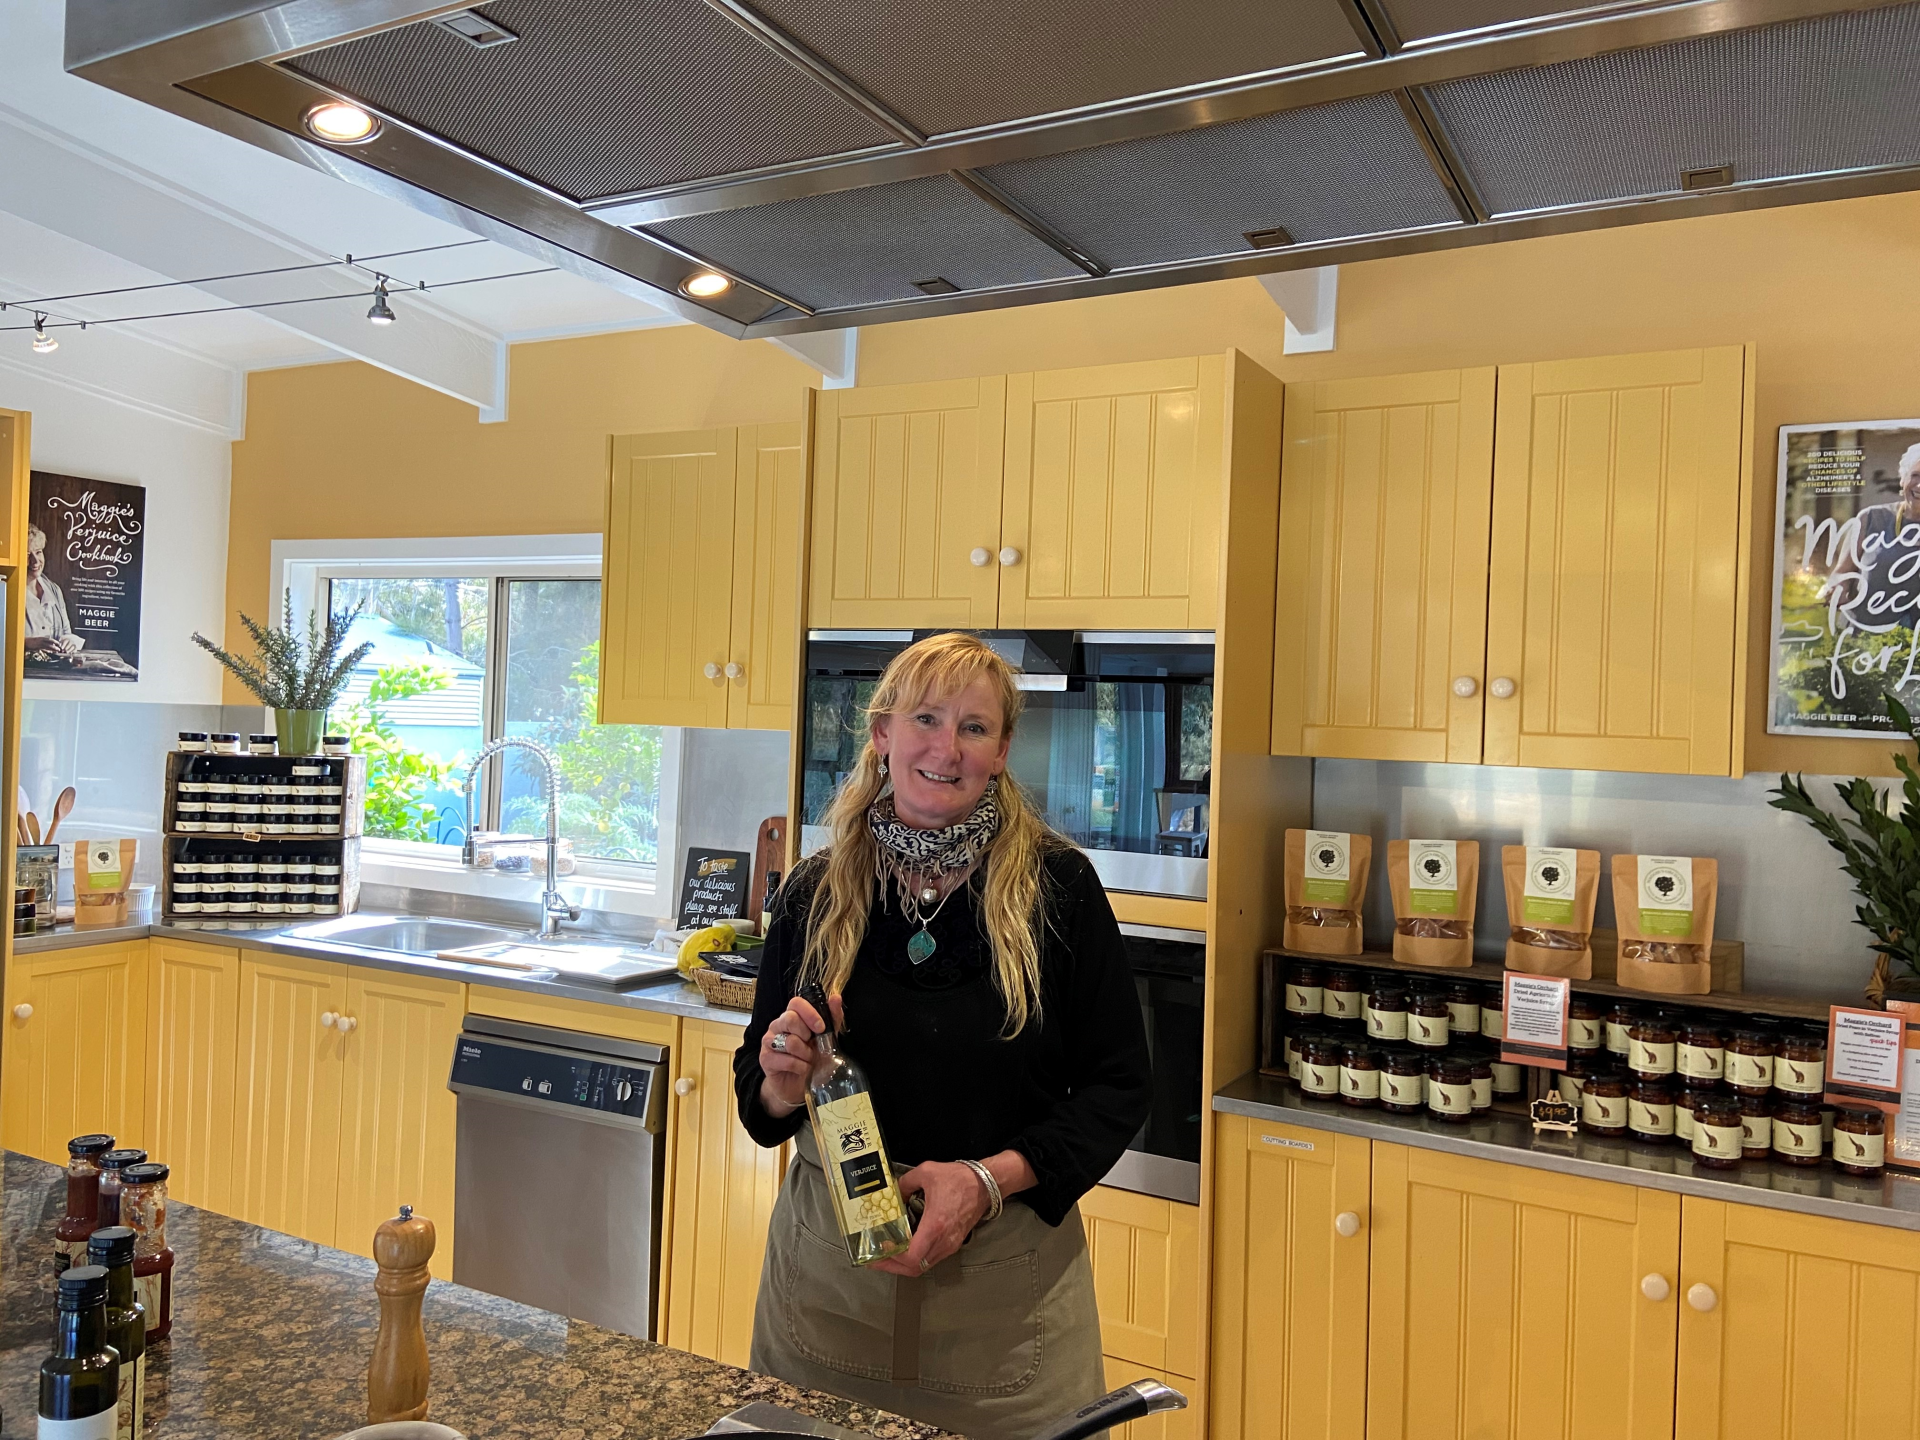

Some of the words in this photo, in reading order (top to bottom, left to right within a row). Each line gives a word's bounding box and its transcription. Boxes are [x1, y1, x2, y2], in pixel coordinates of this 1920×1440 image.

[48, 490, 137, 525] Maggie's
[64, 511, 132, 547] Verjuice
[66, 541, 132, 564] Cookbook
[1816, 571, 1920, 636] Rec
[79, 608, 116, 618] MAGGIE
[84, 619, 109, 627] BEER
[1826, 626, 1903, 700] for
[1788, 712, 1827, 720] MAGGIE
[1830, 714, 1857, 722] BEER
[698, 857, 708, 872] To
[710, 860, 728, 873] taste
[689, 878, 704, 888] our
[704, 877, 736, 892] delicious
[693, 889, 723, 901] products
[685, 900, 704, 914] please
[707, 905, 717, 913] see
[718, 903, 738, 918] staff
[691, 914, 700, 925] at
[702, 917, 715, 925] our
[1517, 996, 1538, 1004] Verjuice
[1868, 1020, 1892, 1028] Orchard
[462, 1046, 481, 1054] Miele
[836, 1120, 866, 1134] MAGGIE
[863, 1126, 872, 1148] BEER
[1266, 1137, 1286, 1145] CUTTING
[1288, 1141, 1309, 1149] BOARDS
[850, 1164, 877, 1177] VERJUICE
